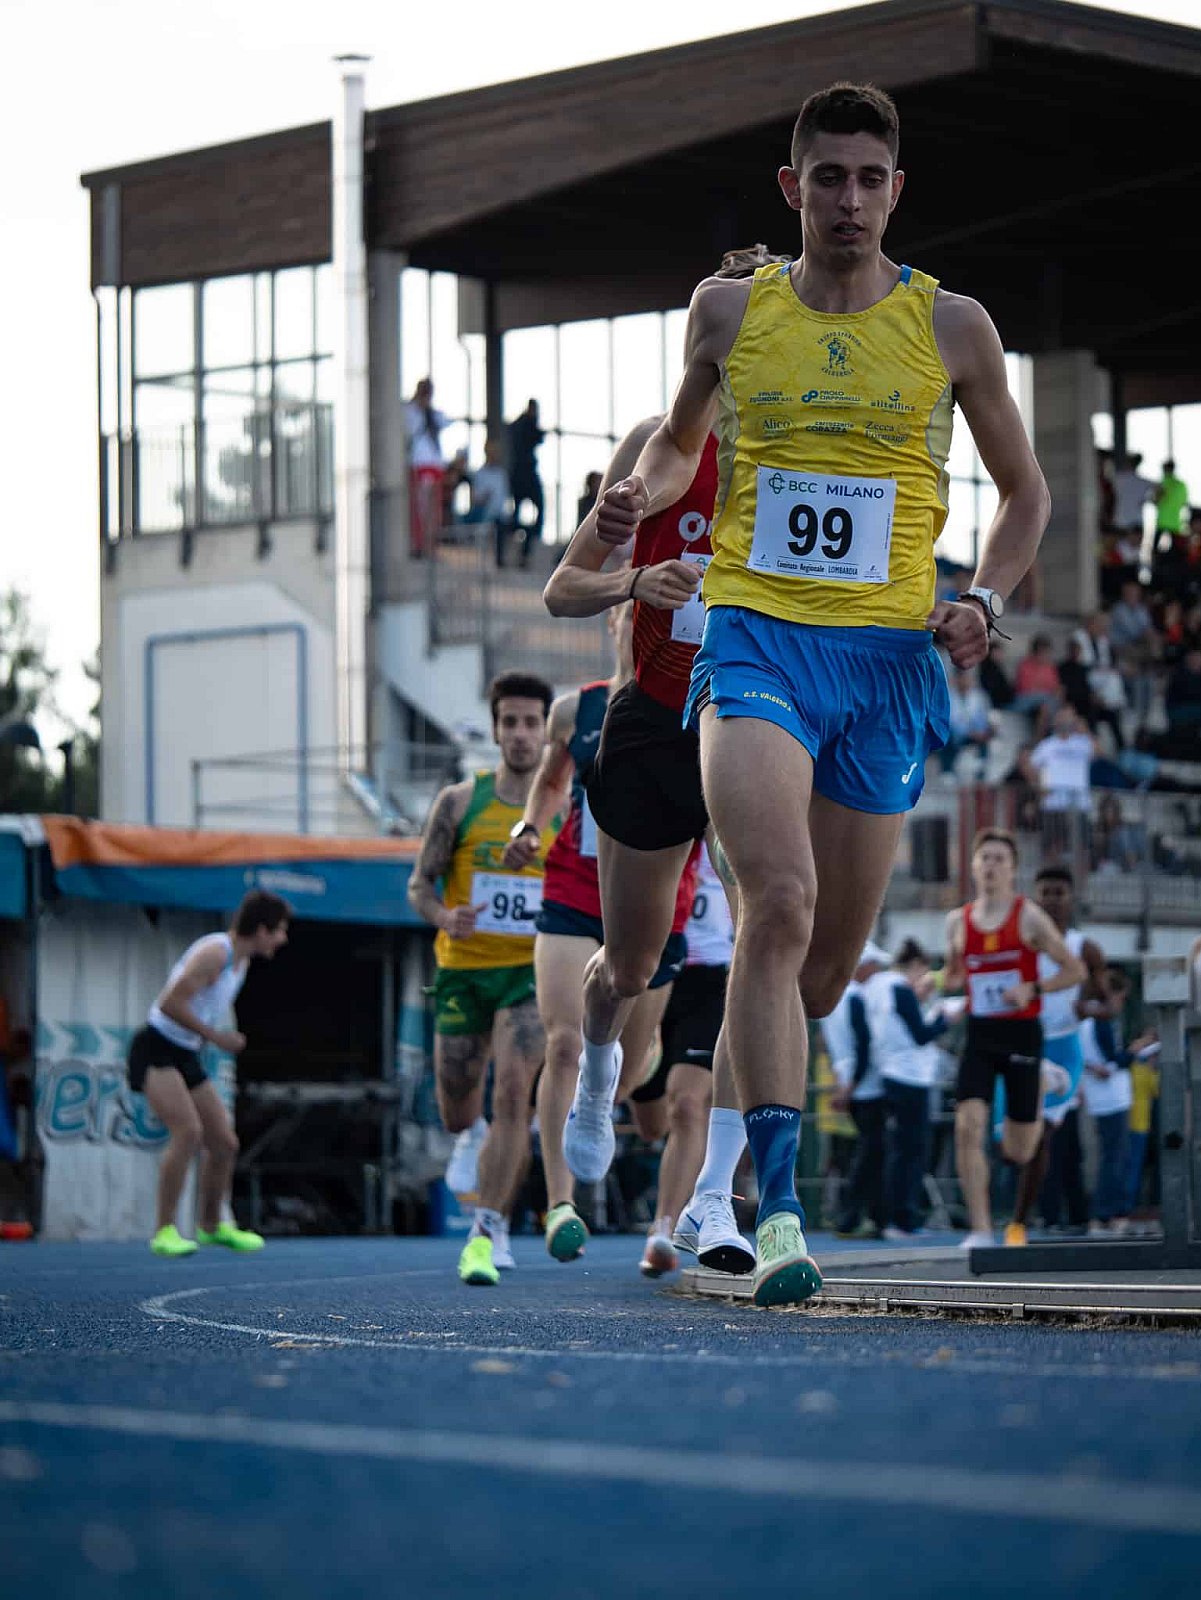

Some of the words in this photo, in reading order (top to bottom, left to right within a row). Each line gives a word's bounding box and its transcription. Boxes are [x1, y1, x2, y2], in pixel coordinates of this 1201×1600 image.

[789, 480, 818, 493] BCC
[826, 484, 885, 499] MILANO
[787, 504, 853, 560] 99
[493, 893, 526, 920] 98
